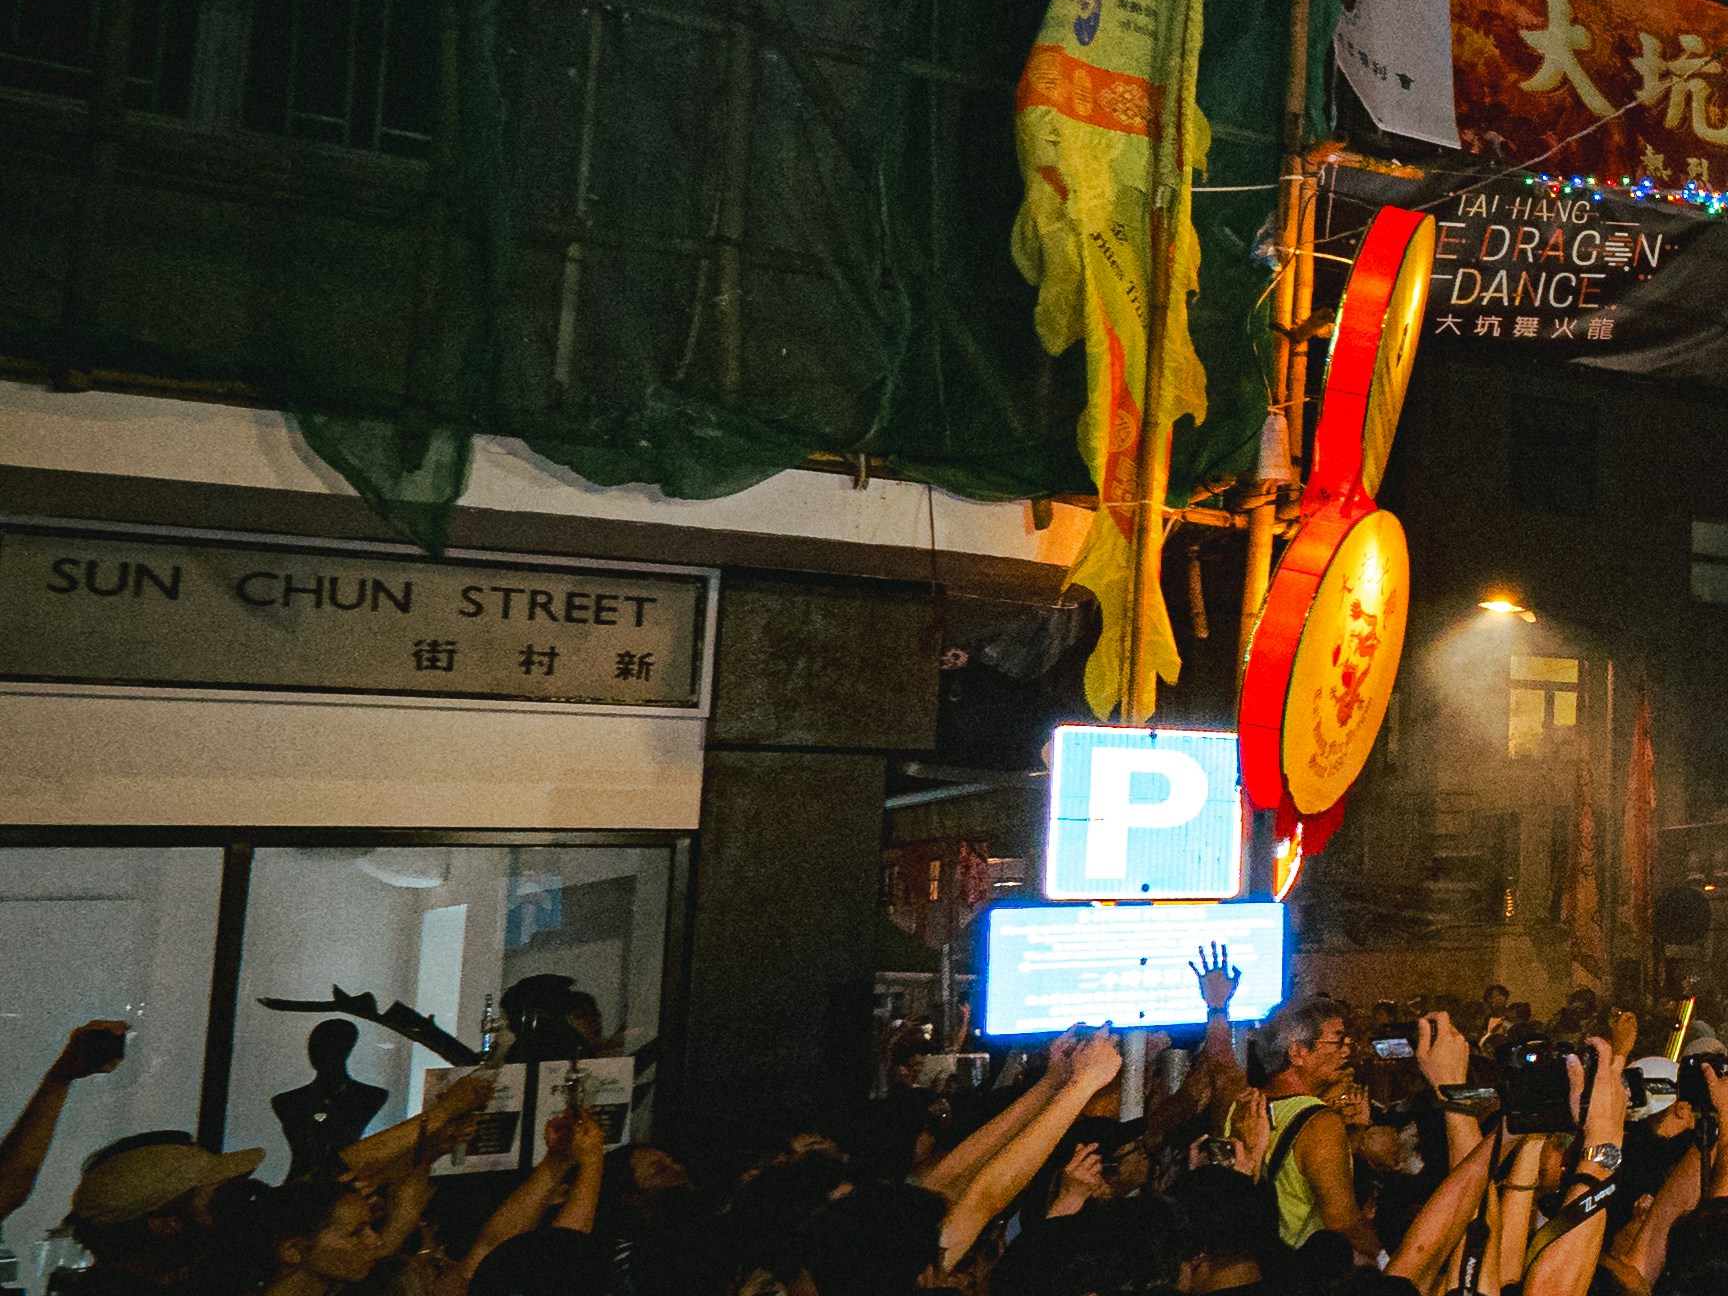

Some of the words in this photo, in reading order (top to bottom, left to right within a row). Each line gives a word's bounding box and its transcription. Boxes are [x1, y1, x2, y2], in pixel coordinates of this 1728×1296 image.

[1450, 270, 1606, 309] DANCE
[1436, 316, 1614, 341] 大坑舞火龍
[47, 557, 181, 601] SUN
[236, 570, 412, 614] CHUN
[459, 585, 657, 628] STREET
[1084, 746, 1209, 880] P
